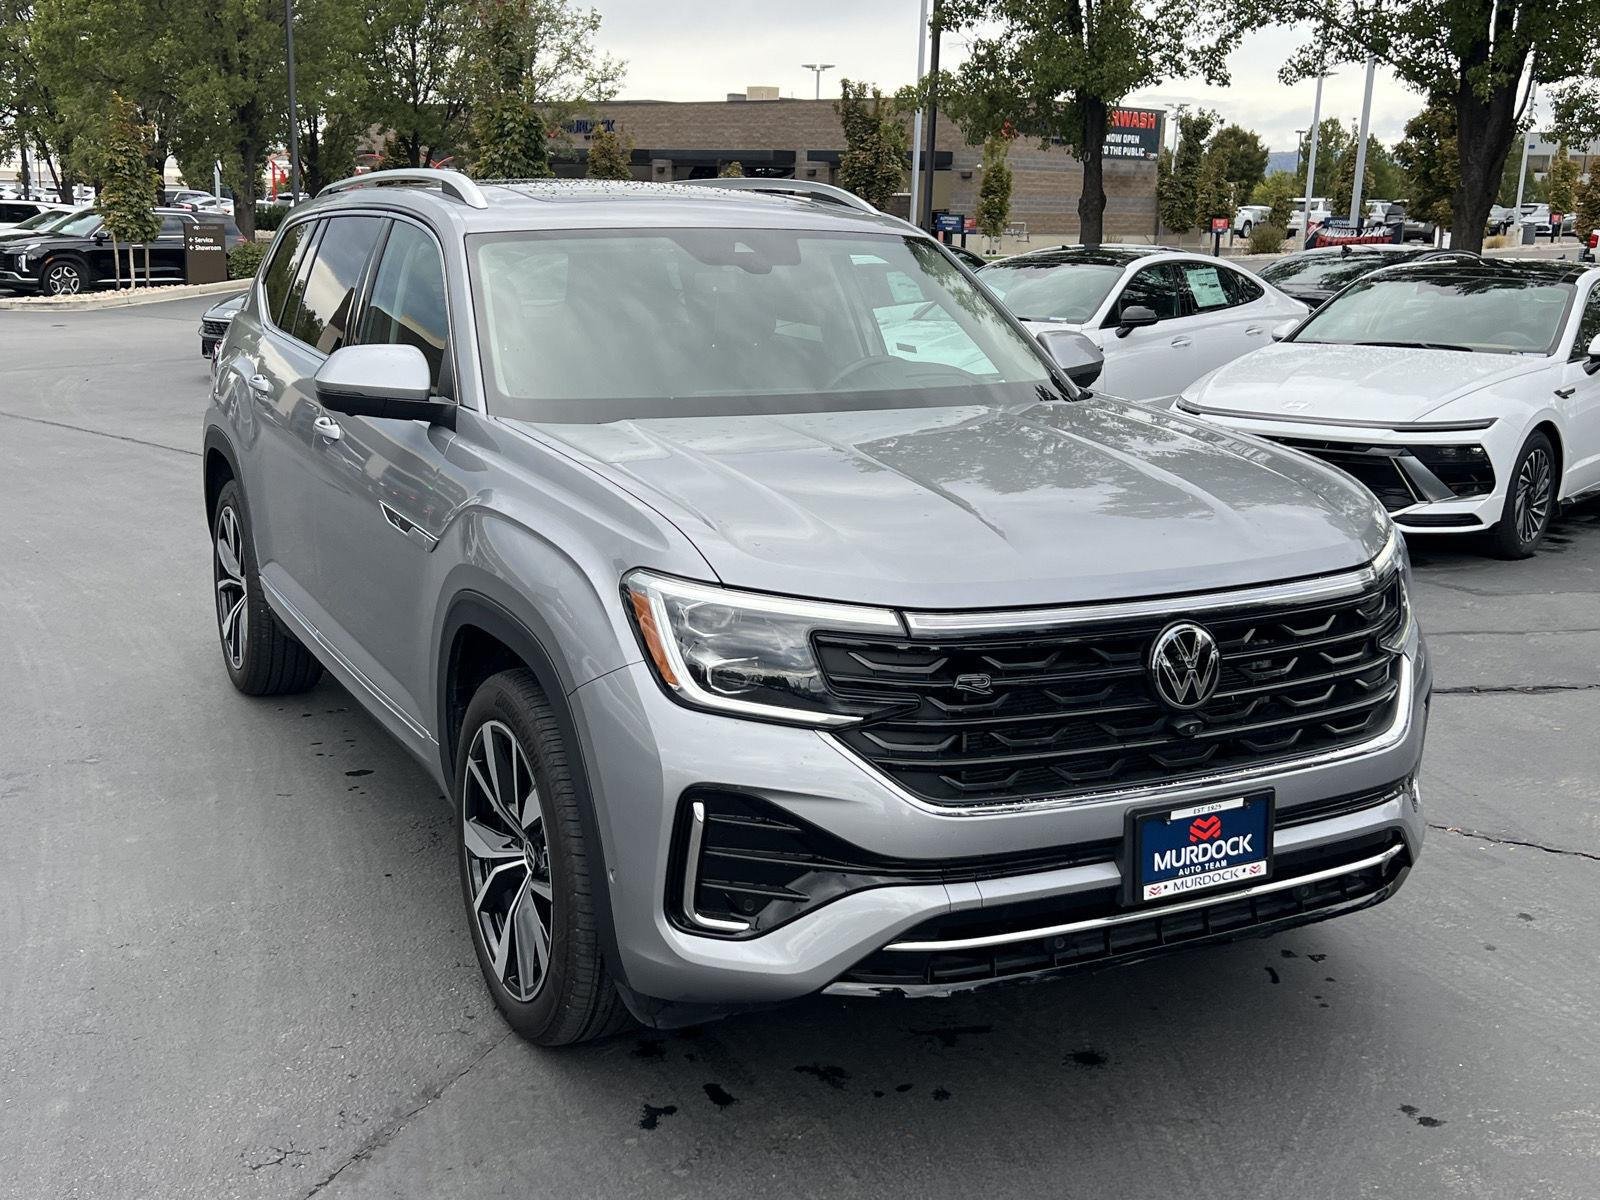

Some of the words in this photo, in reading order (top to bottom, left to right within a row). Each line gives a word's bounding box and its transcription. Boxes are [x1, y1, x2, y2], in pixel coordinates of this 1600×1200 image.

[1111, 110, 1156, 128] RWASH
[1106, 133, 1122, 143] NOW
[1123, 134, 1140, 144] OPEN
[1110, 145, 1122, 155] THE
[1123, 147, 1145, 156] PUBLIC
[1154, 833, 1253, 871] MURDOCK
[1178, 866, 1201, 876] AUTO
[1205, 859, 1228, 871] TEAM
[1173, 868, 1239, 891] MURDOCK
